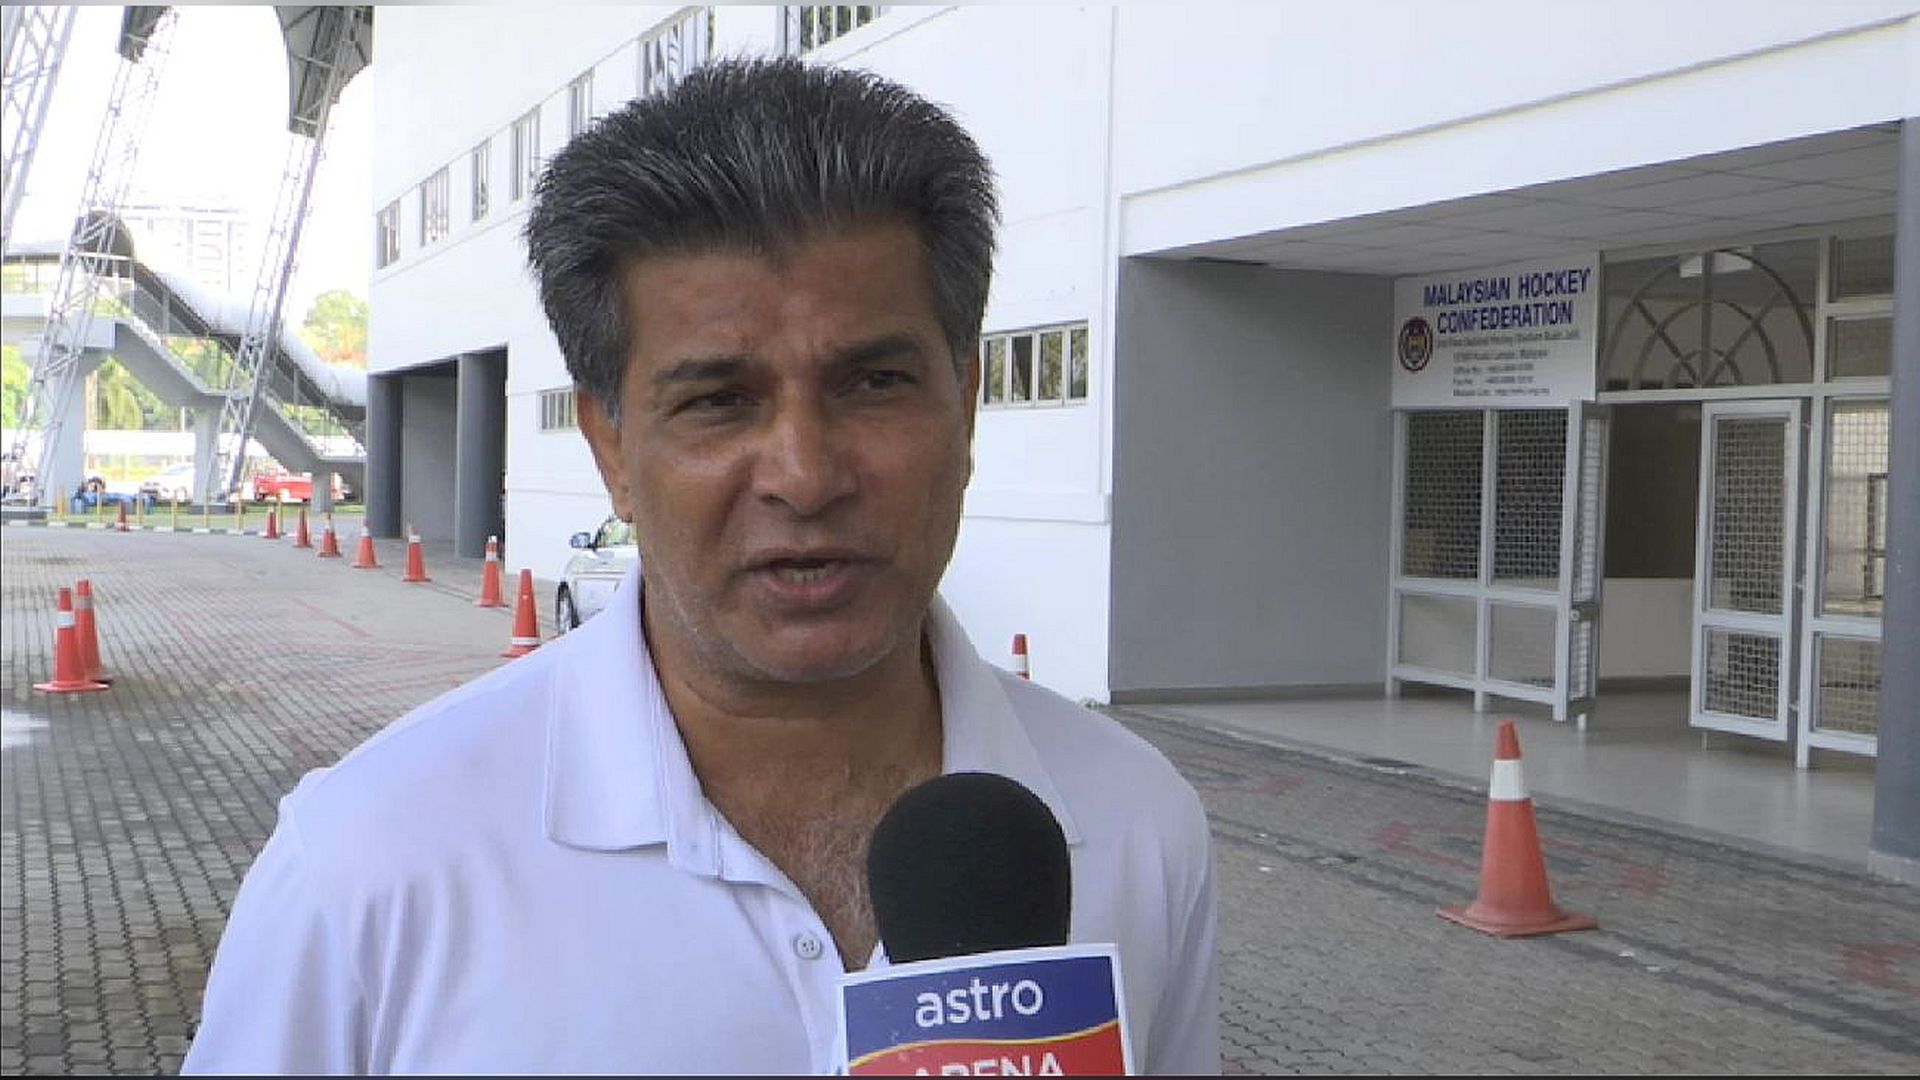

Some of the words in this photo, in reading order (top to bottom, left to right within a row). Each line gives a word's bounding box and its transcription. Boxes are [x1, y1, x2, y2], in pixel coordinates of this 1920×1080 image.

[1423, 277, 1510, 307] MALAYSIAN
[1518, 267, 1591, 299] HOCKEY
[1437, 301, 1573, 333] CONFEDERATION
[915, 976, 1043, 1028] astro
[915, 1052, 1063, 1076] ENA
